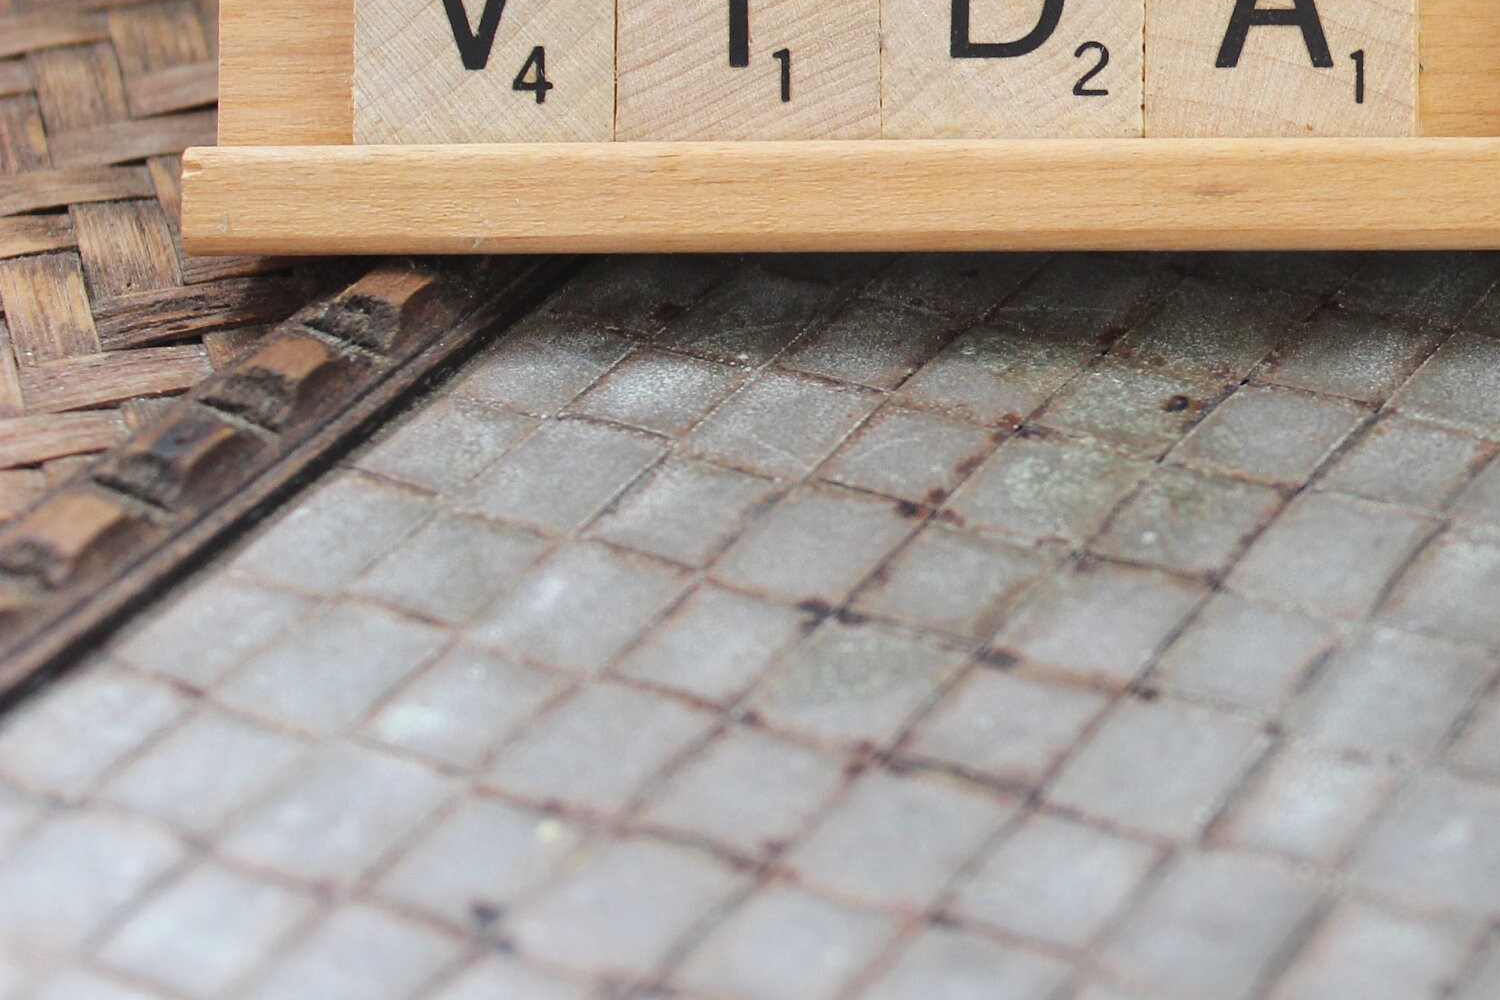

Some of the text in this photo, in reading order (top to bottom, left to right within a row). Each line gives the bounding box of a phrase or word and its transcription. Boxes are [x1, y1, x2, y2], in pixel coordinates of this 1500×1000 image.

[511, 44, 555, 105] 4
[771, 47, 792, 104] 1
[1071, 40, 1111, 98] 2
[1348, 48, 1367, 105] 1
